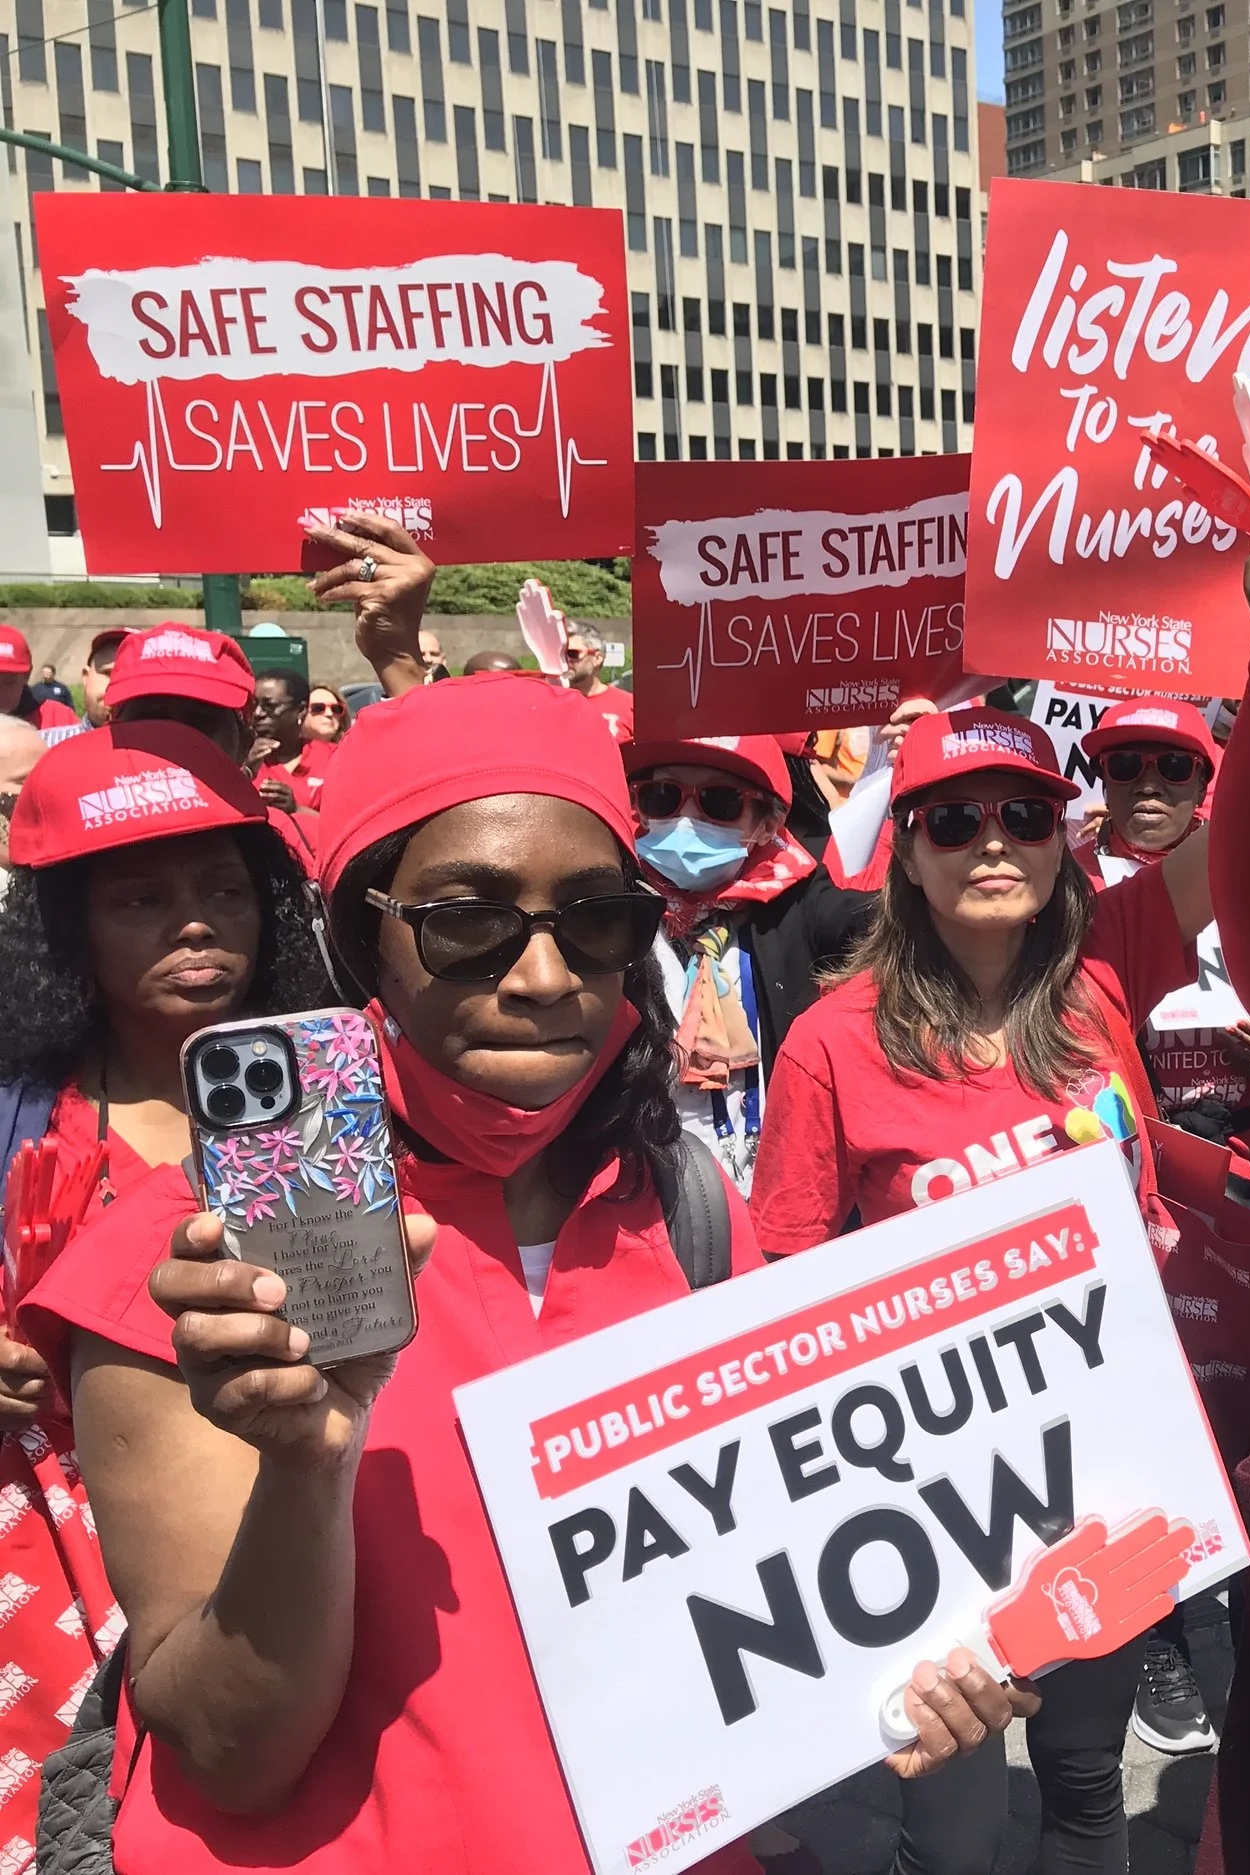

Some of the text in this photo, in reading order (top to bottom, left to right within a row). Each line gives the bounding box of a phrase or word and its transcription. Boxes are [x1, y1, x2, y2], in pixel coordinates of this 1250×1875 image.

[131, 281, 553, 359] SAFE STAFFING
[184, 400, 521, 471] SAVES LIVES
[348, 496, 431, 508] New York State
[986, 466, 1237, 579] Nurses
[699, 515, 969, 587] SAFE STAFFIN
[727, 603, 965, 667] SAVES LIVES
[1099, 610, 1192, 631] New York State
[1047, 618, 1192, 661] NURSES
[1046, 649, 1192, 674] ASSOCIATION
[805, 701, 899, 714] ASSOCIATION
[806, 685, 900, 707] NURSES
[942, 729, 1032, 754] NURSES
[78, 776, 197, 820] NURSES
[84, 797, 206, 831] ASSOCIATION
[1150, 1051, 1208, 1070] NITED
[911, 1114, 1060, 1207] ONE
[269, 1220, 288, 1233] For
[300, 1212, 333, 1226] know
[335, 1208, 353, 1220] the
[274, 1246, 383, 1279] lares the Lord
[281, 1247, 309, 1260] have
[312, 1242, 329, 1254] for
[298, 1271, 366, 1295] Prosper
[370, 1264, 393, 1278] you
[291, 1300, 310, 1312] not
[314, 1297, 325, 1308] to
[328, 1291, 359, 1304] harm
[361, 1285, 384, 1300] you
[312, 1312, 324, 1323] to
[326, 1307, 351, 1321] give
[353, 1301, 376, 1317] you
[544, 1227, 1085, 1473] PUBLIC SECTOR NURSES SAY:
[548, 1283, 1107, 1608] PAY EQUITY
[686, 1415, 1077, 1727] NOW
[677, 1794, 699, 1812] York
[623, 1788, 724, 1867] NURSES
[634, 1807, 732, 1875] ASSOCIATION
